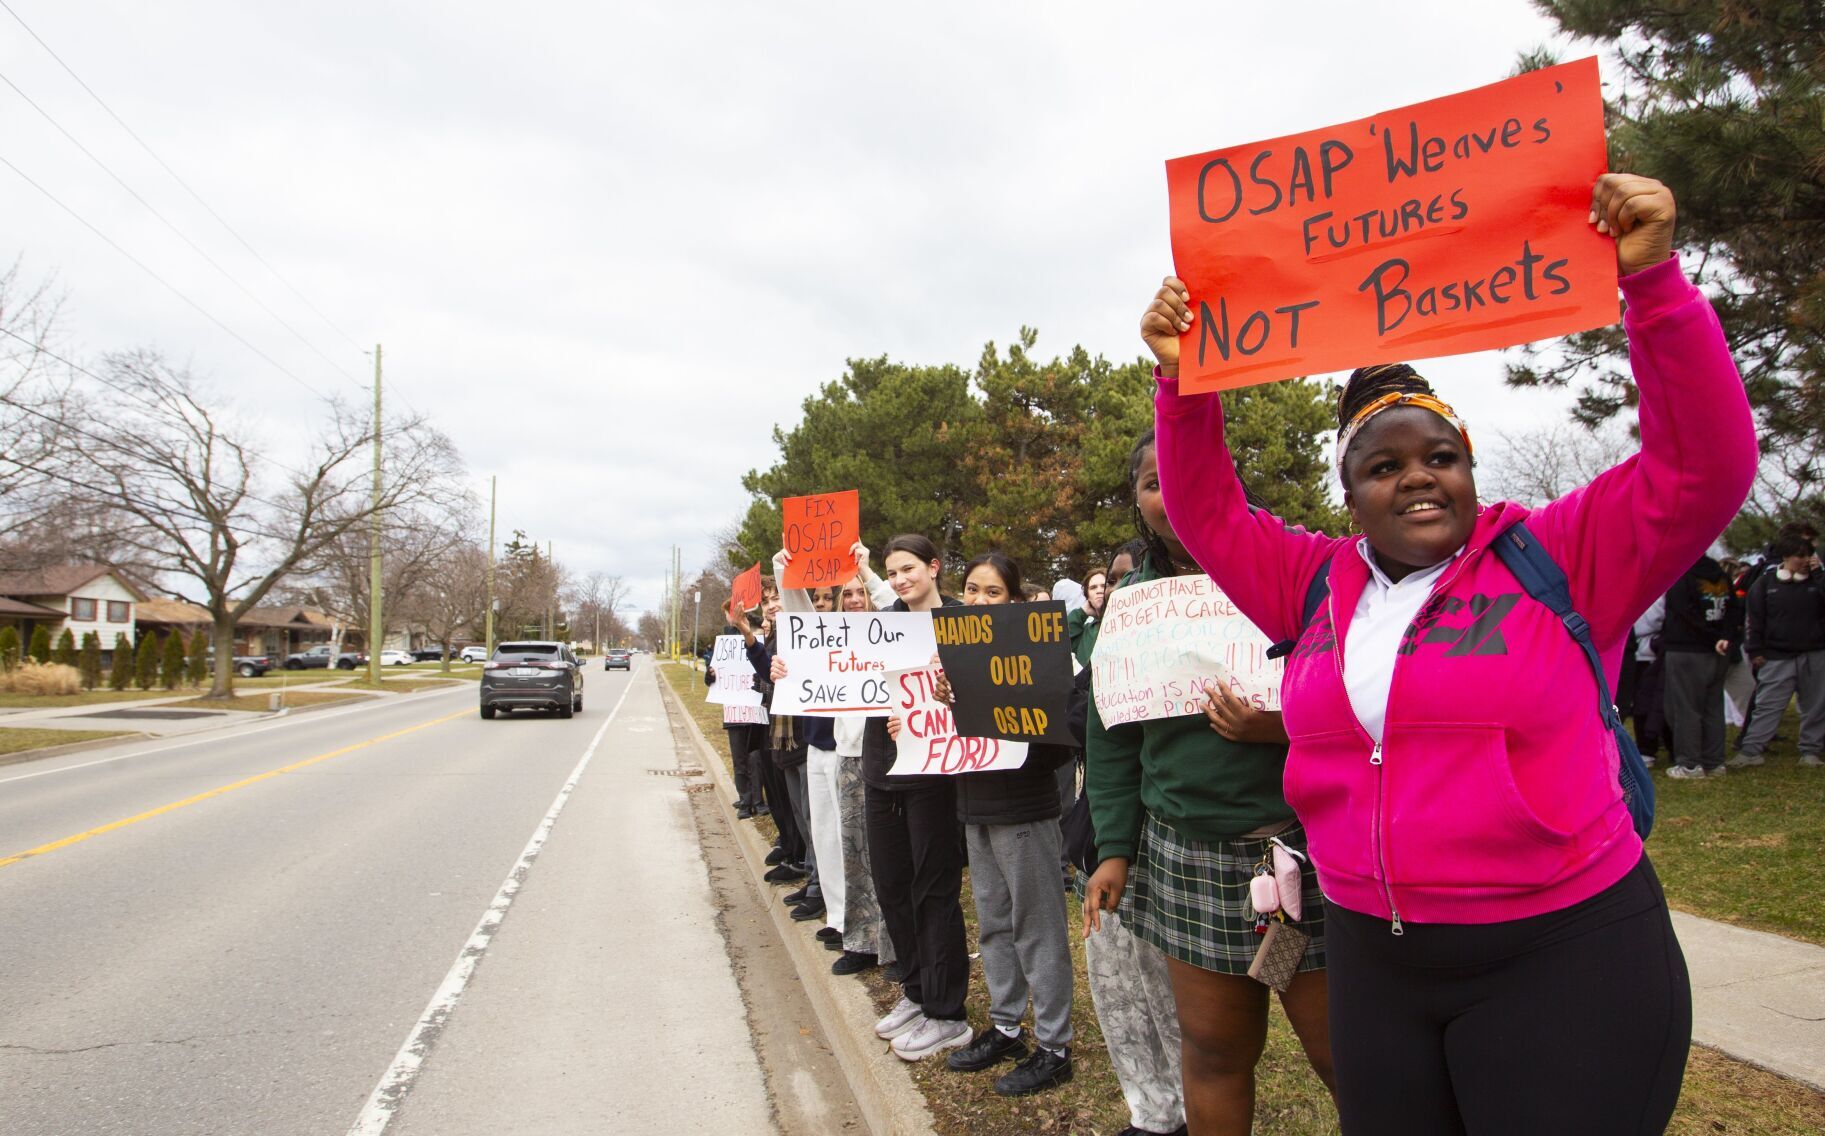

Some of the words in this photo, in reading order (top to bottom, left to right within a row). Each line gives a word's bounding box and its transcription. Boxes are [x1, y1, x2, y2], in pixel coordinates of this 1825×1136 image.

[1197, 139, 1354, 224] OSAP
[1303, 188, 1469, 256] FUTURES
[1198, 296, 1320, 368] NOT
[1358, 240, 1571, 337] Baskets
[805, 498, 835, 518] FIX
[787, 520, 843, 554] OSAP
[803, 558, 841, 582] ASAP
[1169, 579, 1206, 597] HAVE
[1164, 599, 1179, 618] A
[1185, 599, 1237, 618] CARE
[789, 615, 851, 650] Protect
[868, 617, 905, 645] Our
[933, 614, 993, 646] HANDS
[1027, 611, 1064, 643] OFF
[716, 638, 738, 661] OSAP
[828, 650, 885, 673] Futures
[989, 655, 1034, 686] OUR
[1230, 675, 1245, 692] A
[799, 679, 847, 704] SAVE
[861, 678, 891, 704] OS
[993, 706, 1048, 736] OSAP
[921, 735, 1000, 774] FORD
